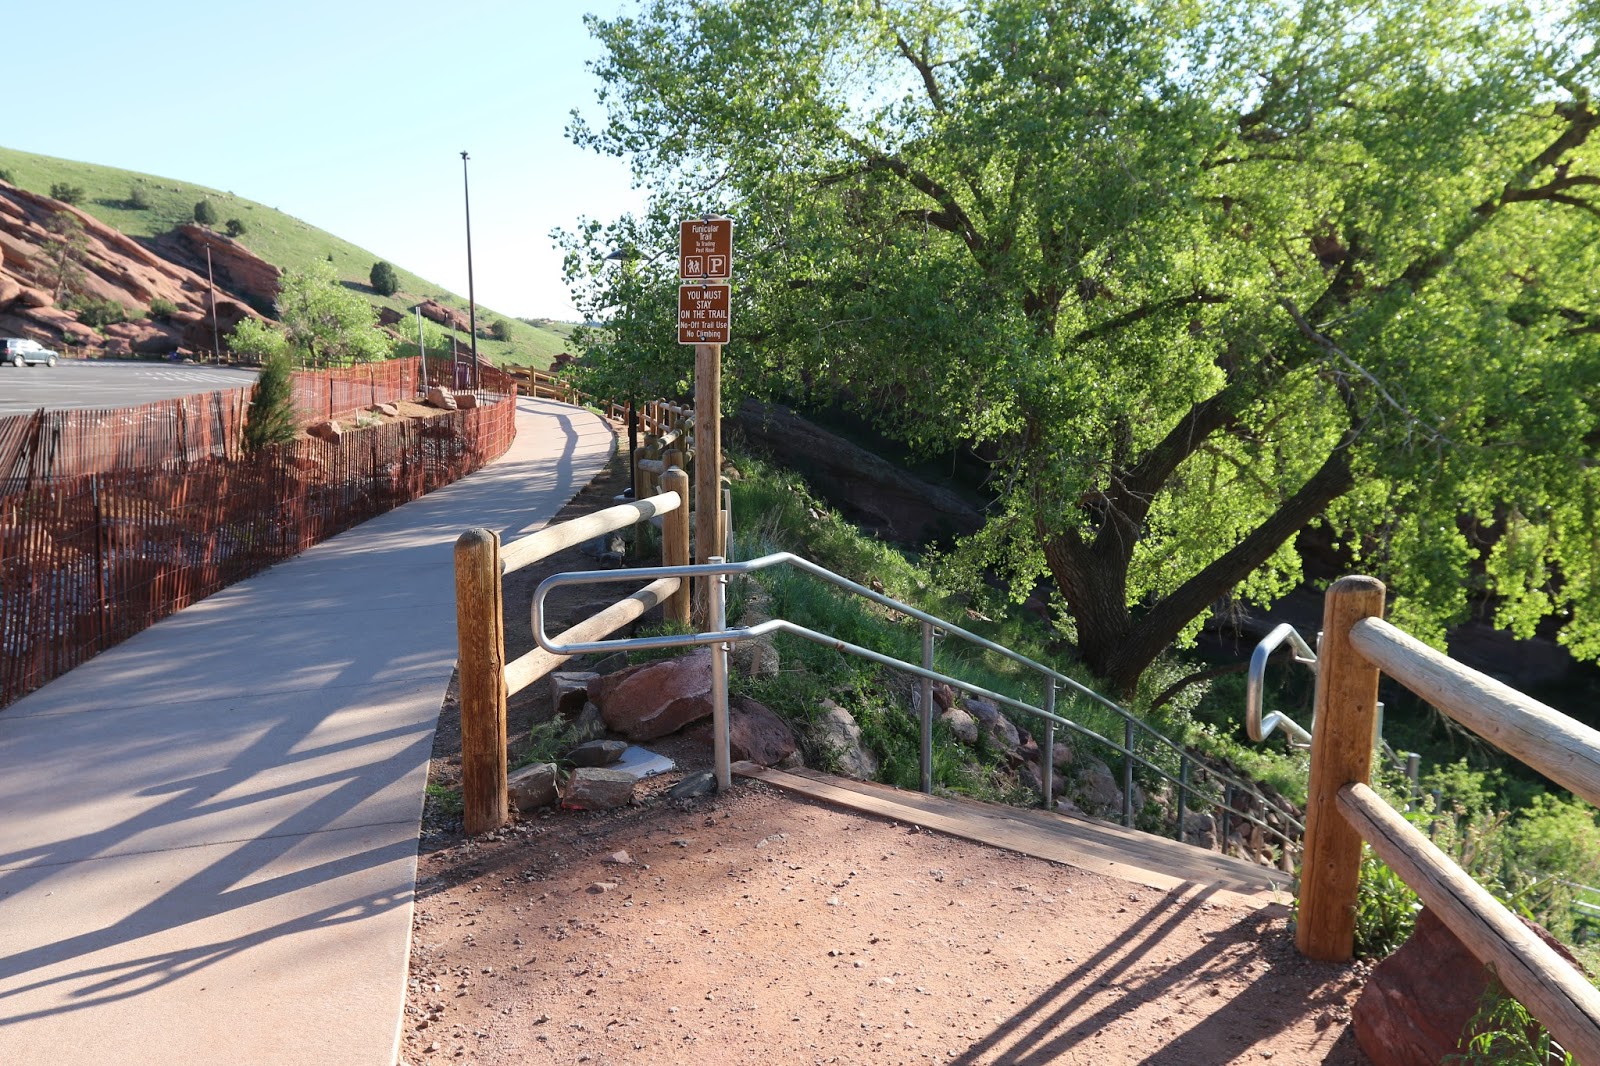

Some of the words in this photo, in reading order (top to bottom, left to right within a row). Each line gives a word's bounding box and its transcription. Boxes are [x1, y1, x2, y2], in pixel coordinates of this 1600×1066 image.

[711, 258, 722, 272] P
[687, 291, 700, 300] YOU
[704, 291, 722, 299] MUST
[696, 301, 712, 309] STAY
[681, 310, 690, 318] ON
[693, 310, 706, 318] THE
[708, 310, 728, 318] TRAIL
[696, 330, 720, 339] Climbing
